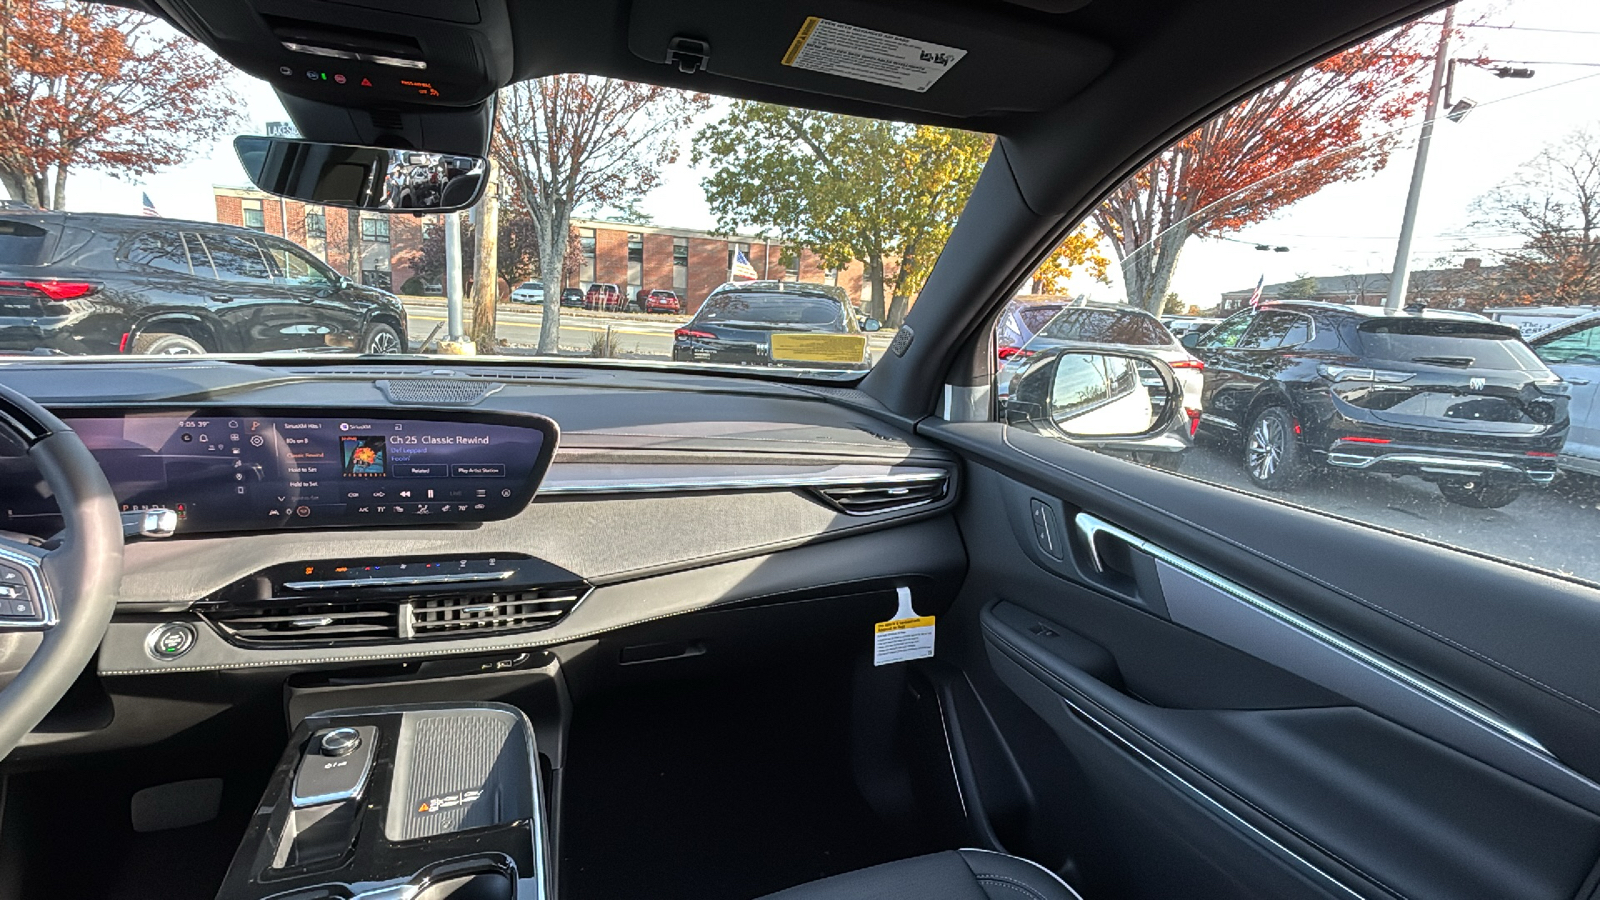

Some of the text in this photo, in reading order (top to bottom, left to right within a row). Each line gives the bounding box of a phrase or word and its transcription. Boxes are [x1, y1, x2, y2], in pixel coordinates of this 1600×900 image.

[389, 435, 490, 445] Ch 25 Classic Rewind
